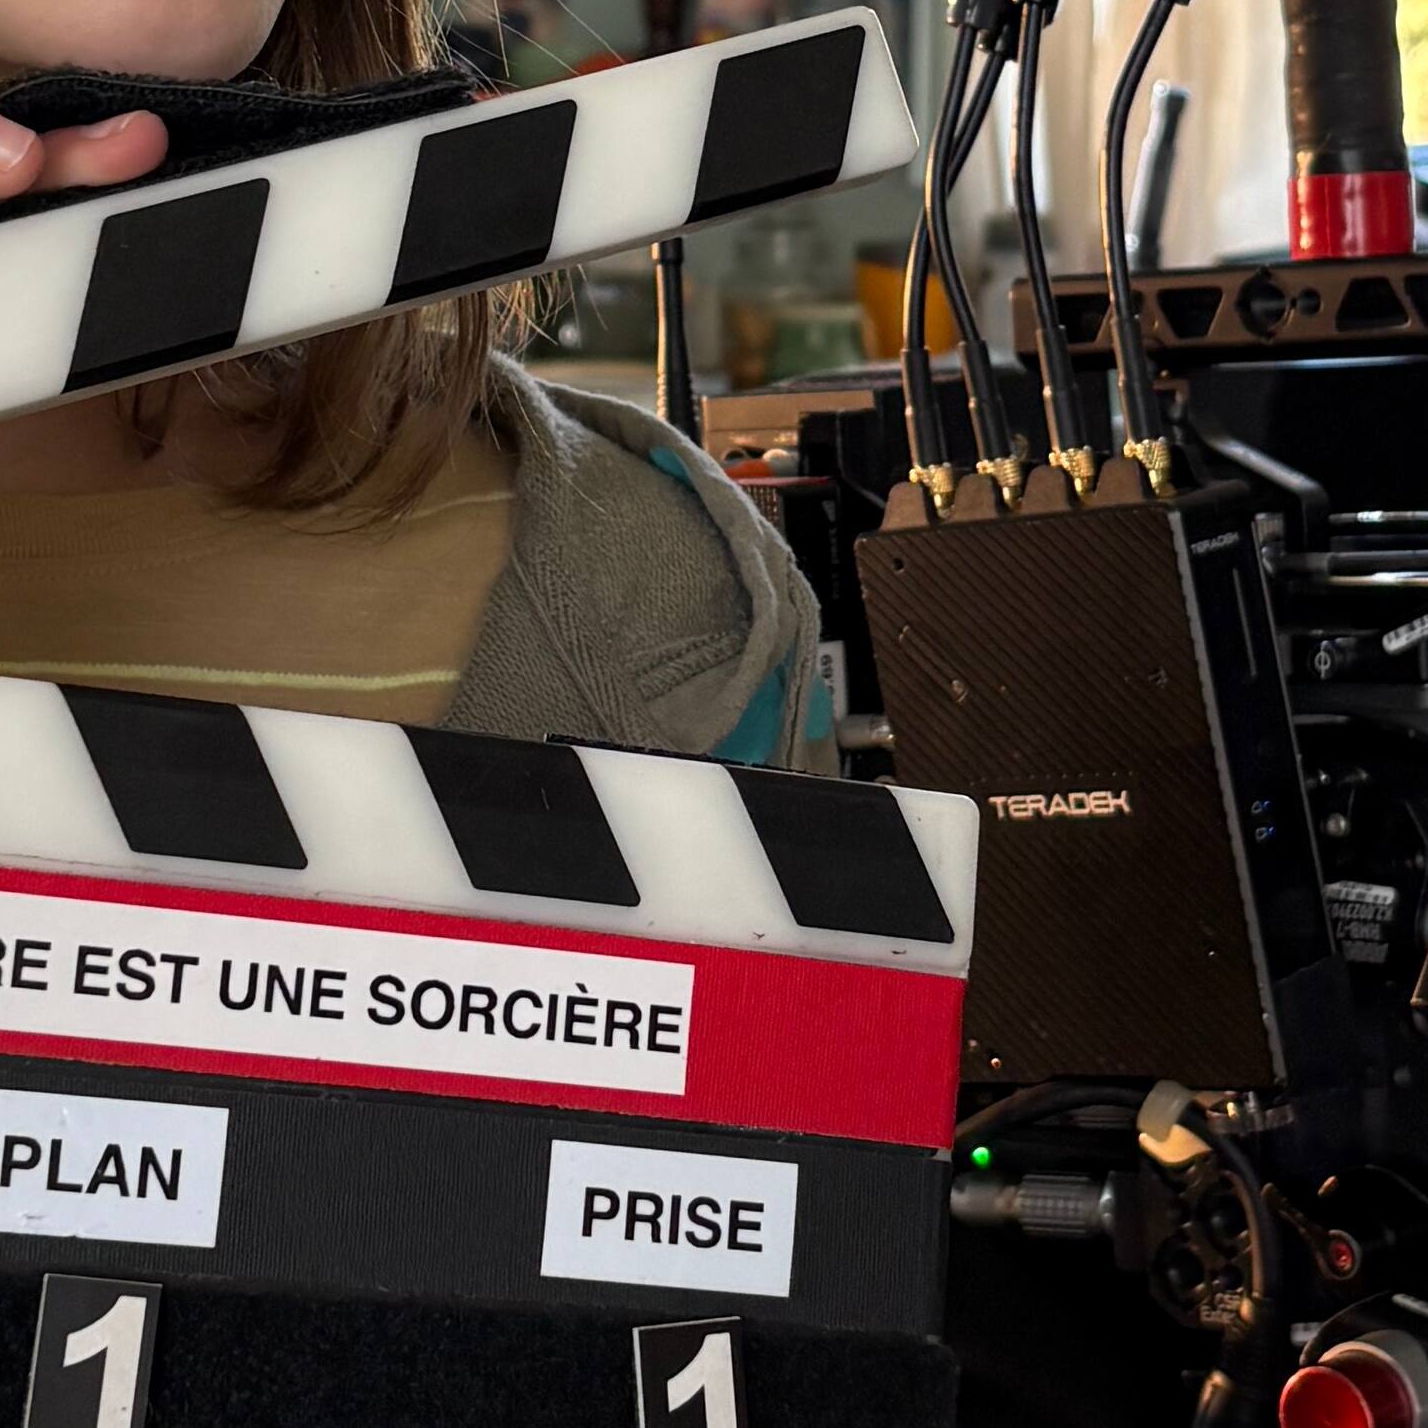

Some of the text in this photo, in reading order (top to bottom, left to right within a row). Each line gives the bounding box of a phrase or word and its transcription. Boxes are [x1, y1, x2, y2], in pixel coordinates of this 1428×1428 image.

[988, 790, 1133, 821] TERADEK
[74, 946, 199, 1003] EST
[220, 960, 346, 1019] UNE
[368, 974, 683, 1054] SORCIÈRE
[0, 1136, 182, 1200] PLAN
[582, 1187, 764, 1252] PRISE
